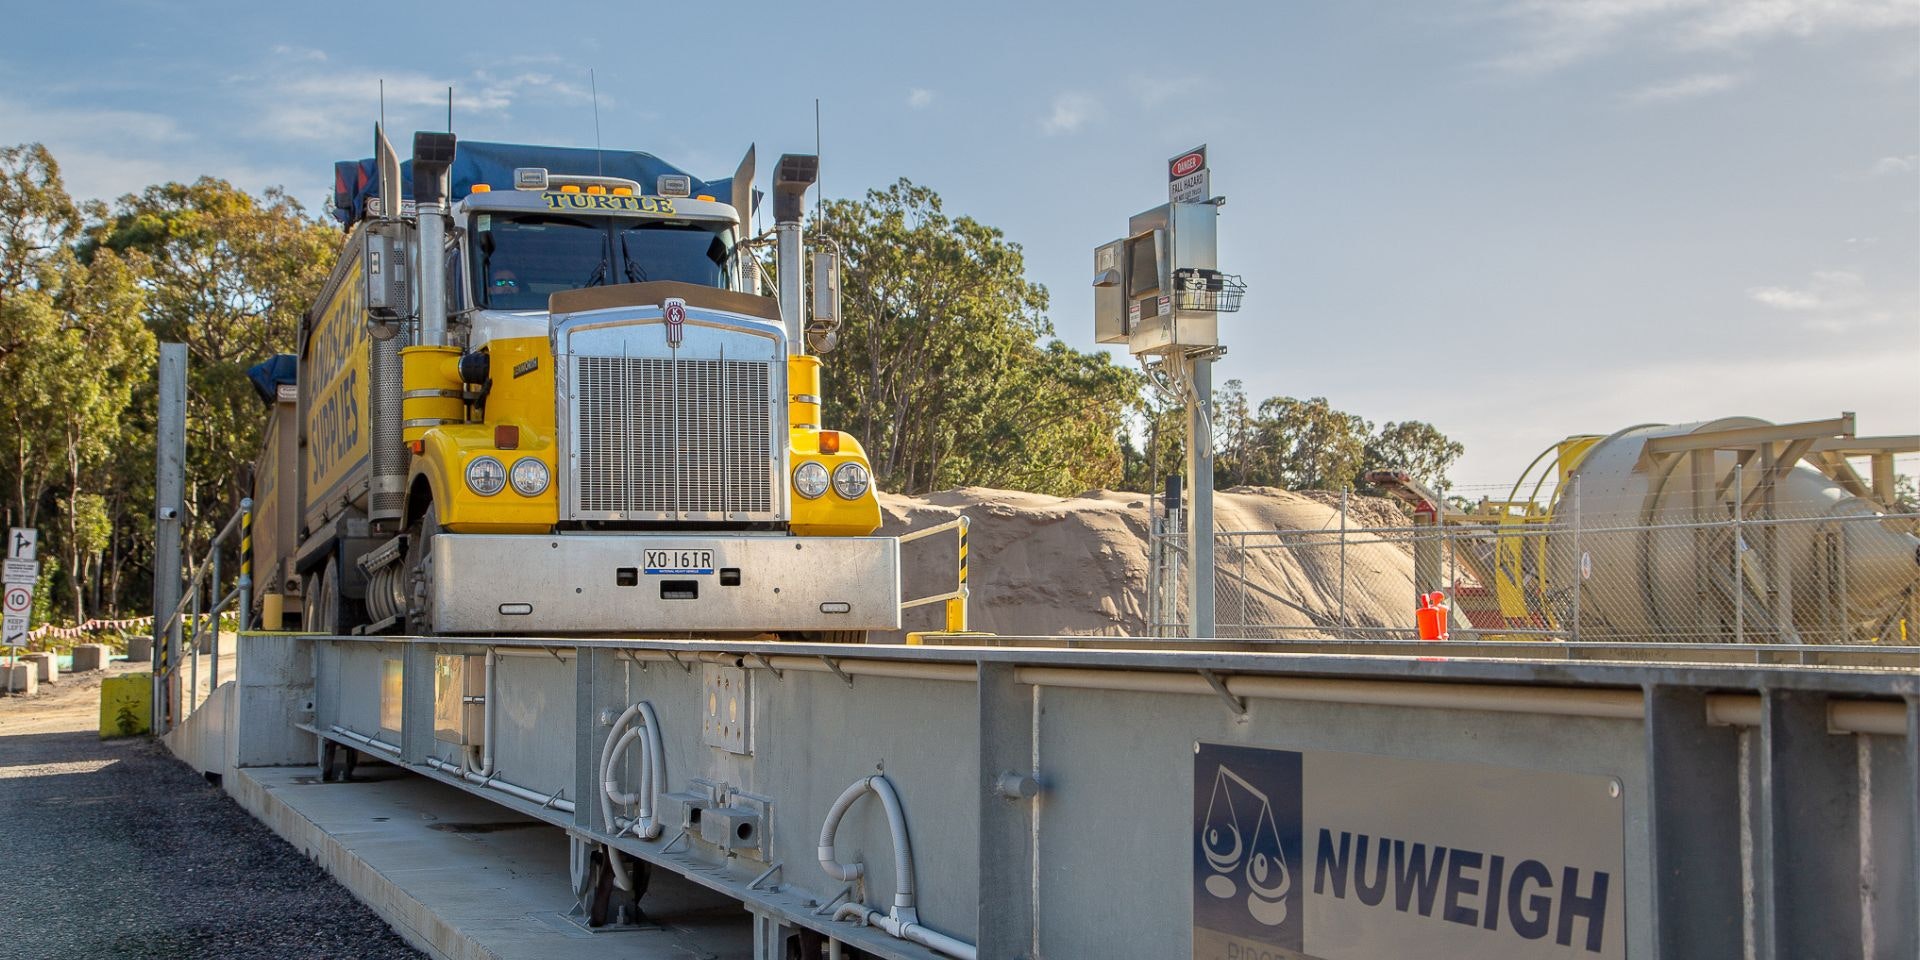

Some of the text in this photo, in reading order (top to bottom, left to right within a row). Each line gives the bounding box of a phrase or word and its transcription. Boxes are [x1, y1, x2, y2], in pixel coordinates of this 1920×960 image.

[1177, 156, 1197, 174] DANGER
[1172, 174, 1204, 193] FALL HAZARD
[542, 191, 676, 216] TURTLE
[312, 368, 358, 485] SUPPLIES
[11, 594, 25, 605] 10
[1314, 828, 1610, 954] NUWEIGH
